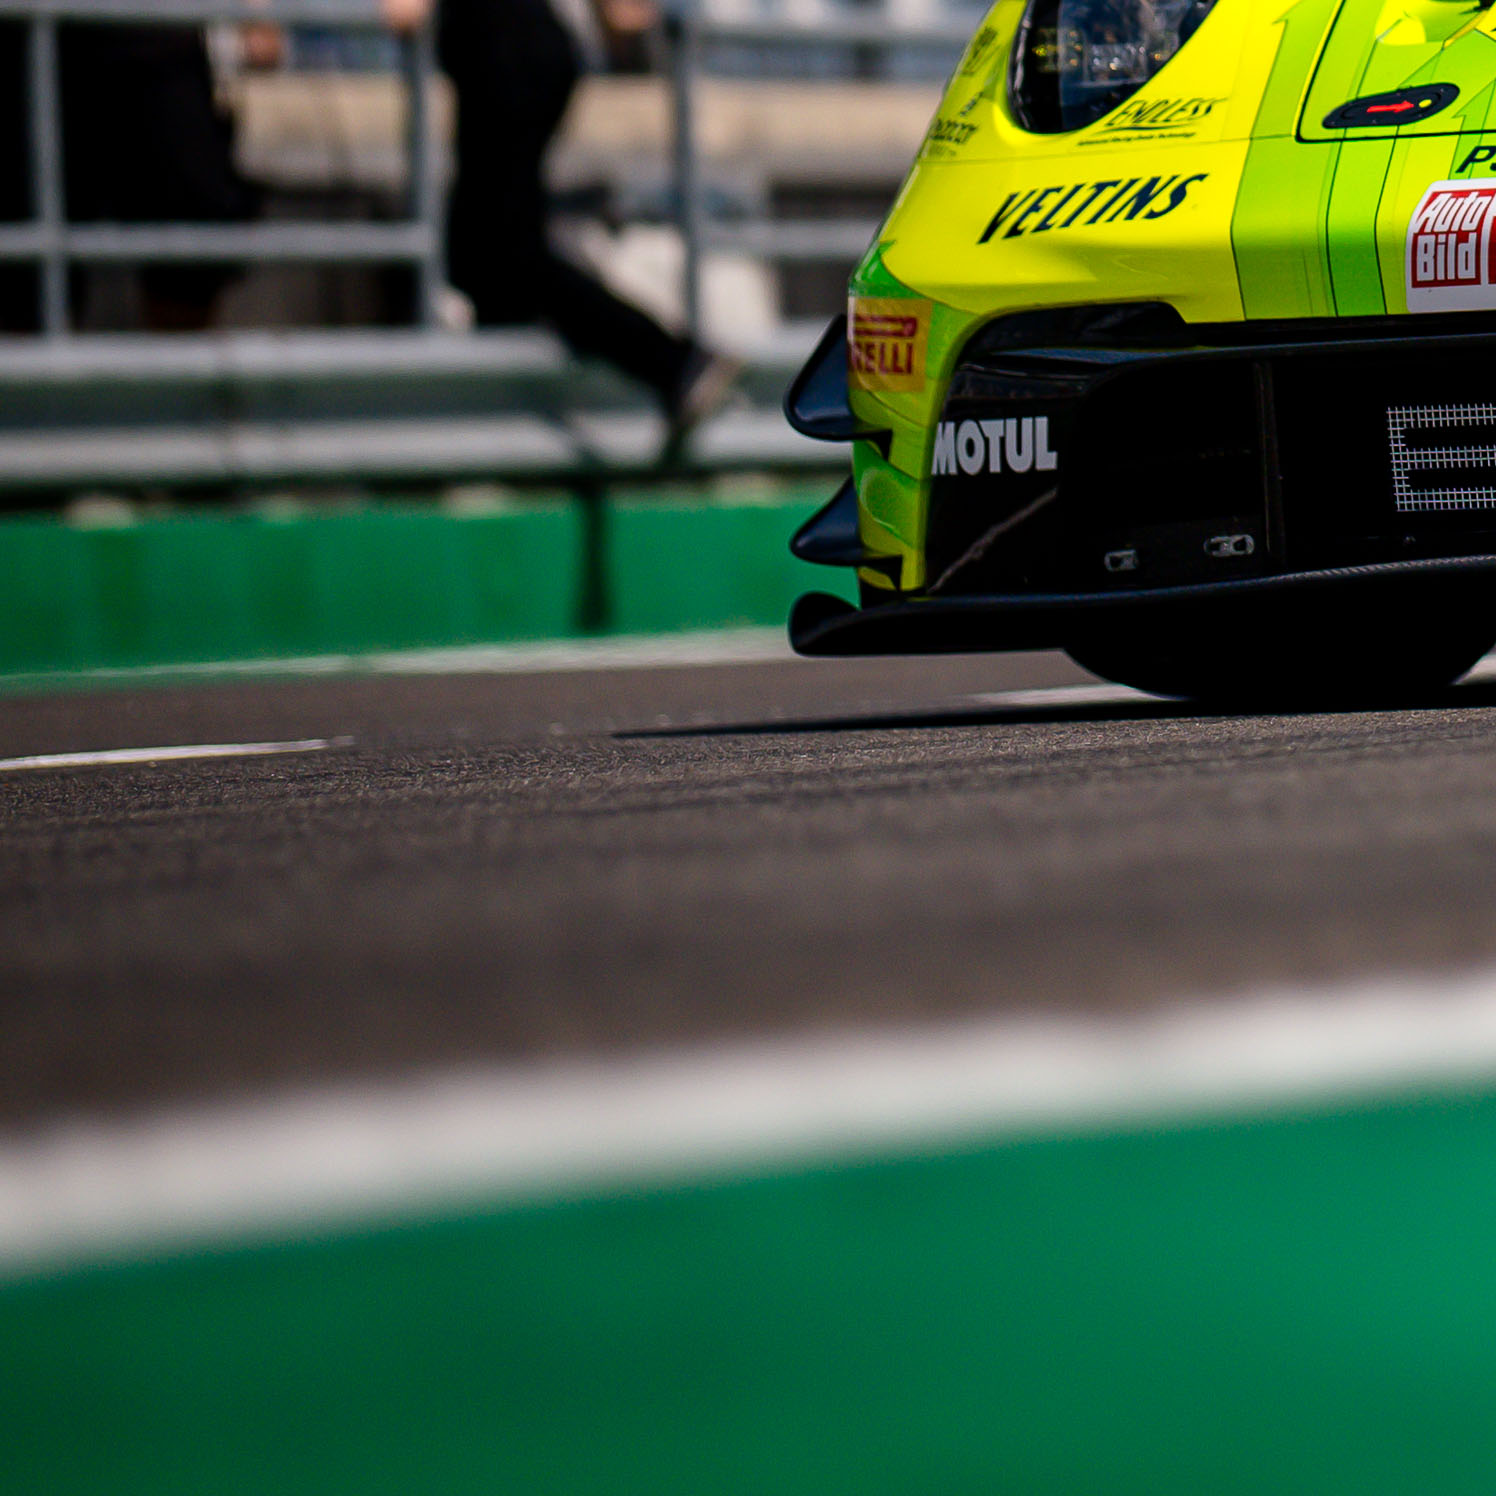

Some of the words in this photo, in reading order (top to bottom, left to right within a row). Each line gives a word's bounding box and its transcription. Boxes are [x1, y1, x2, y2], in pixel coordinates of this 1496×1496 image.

[978, 173, 1209, 245] VELTINS
[1414, 191, 1495, 234] Auto
[1416, 233, 1477, 281] Bild
[932, 417, 1058, 476] MOTUL
